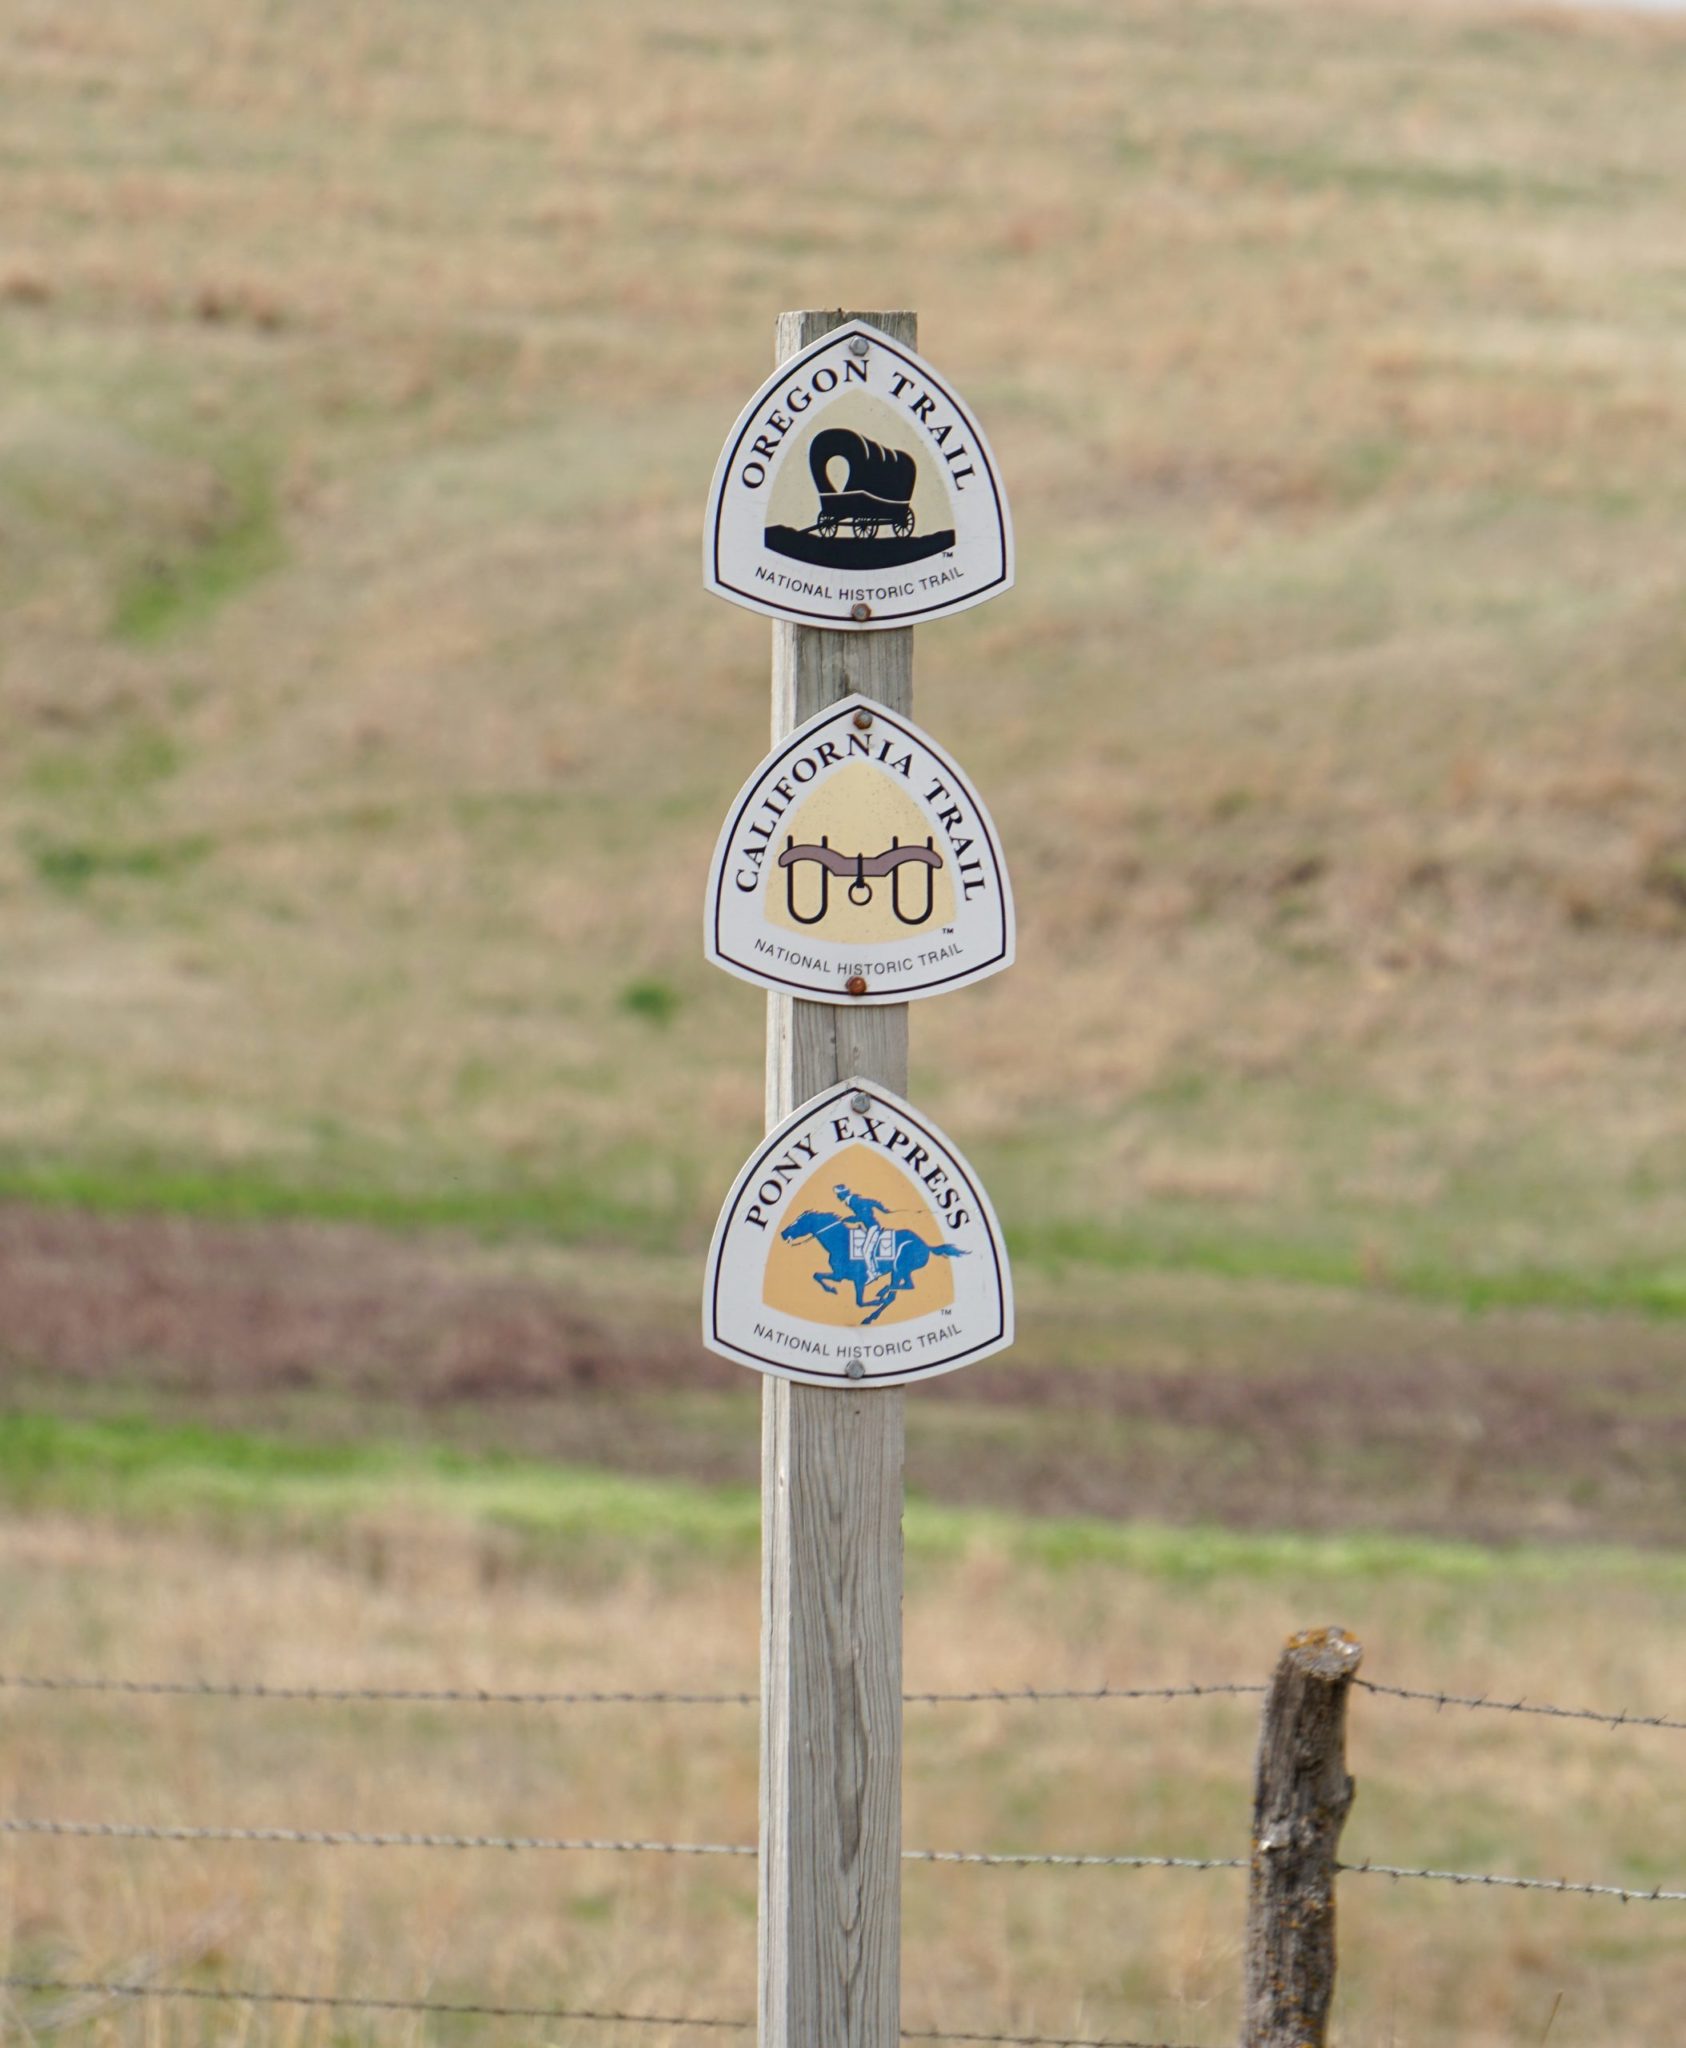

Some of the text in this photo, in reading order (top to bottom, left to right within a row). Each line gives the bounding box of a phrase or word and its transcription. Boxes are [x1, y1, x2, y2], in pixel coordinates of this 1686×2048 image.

[742, 359, 975, 491] OREGON TRAIL
[755, 566, 964, 601] NATIONAL HISTORIC TRAIL
[736, 733, 986, 901] CALIFORNIA TRAIL
[754, 938, 964, 976] NATIONAL HISTORIC TRAIL
[744, 1116, 970, 1232] PONY EXPRESS
[753, 1323, 963, 1358] NATIONAL HISTORIC TRAIL
